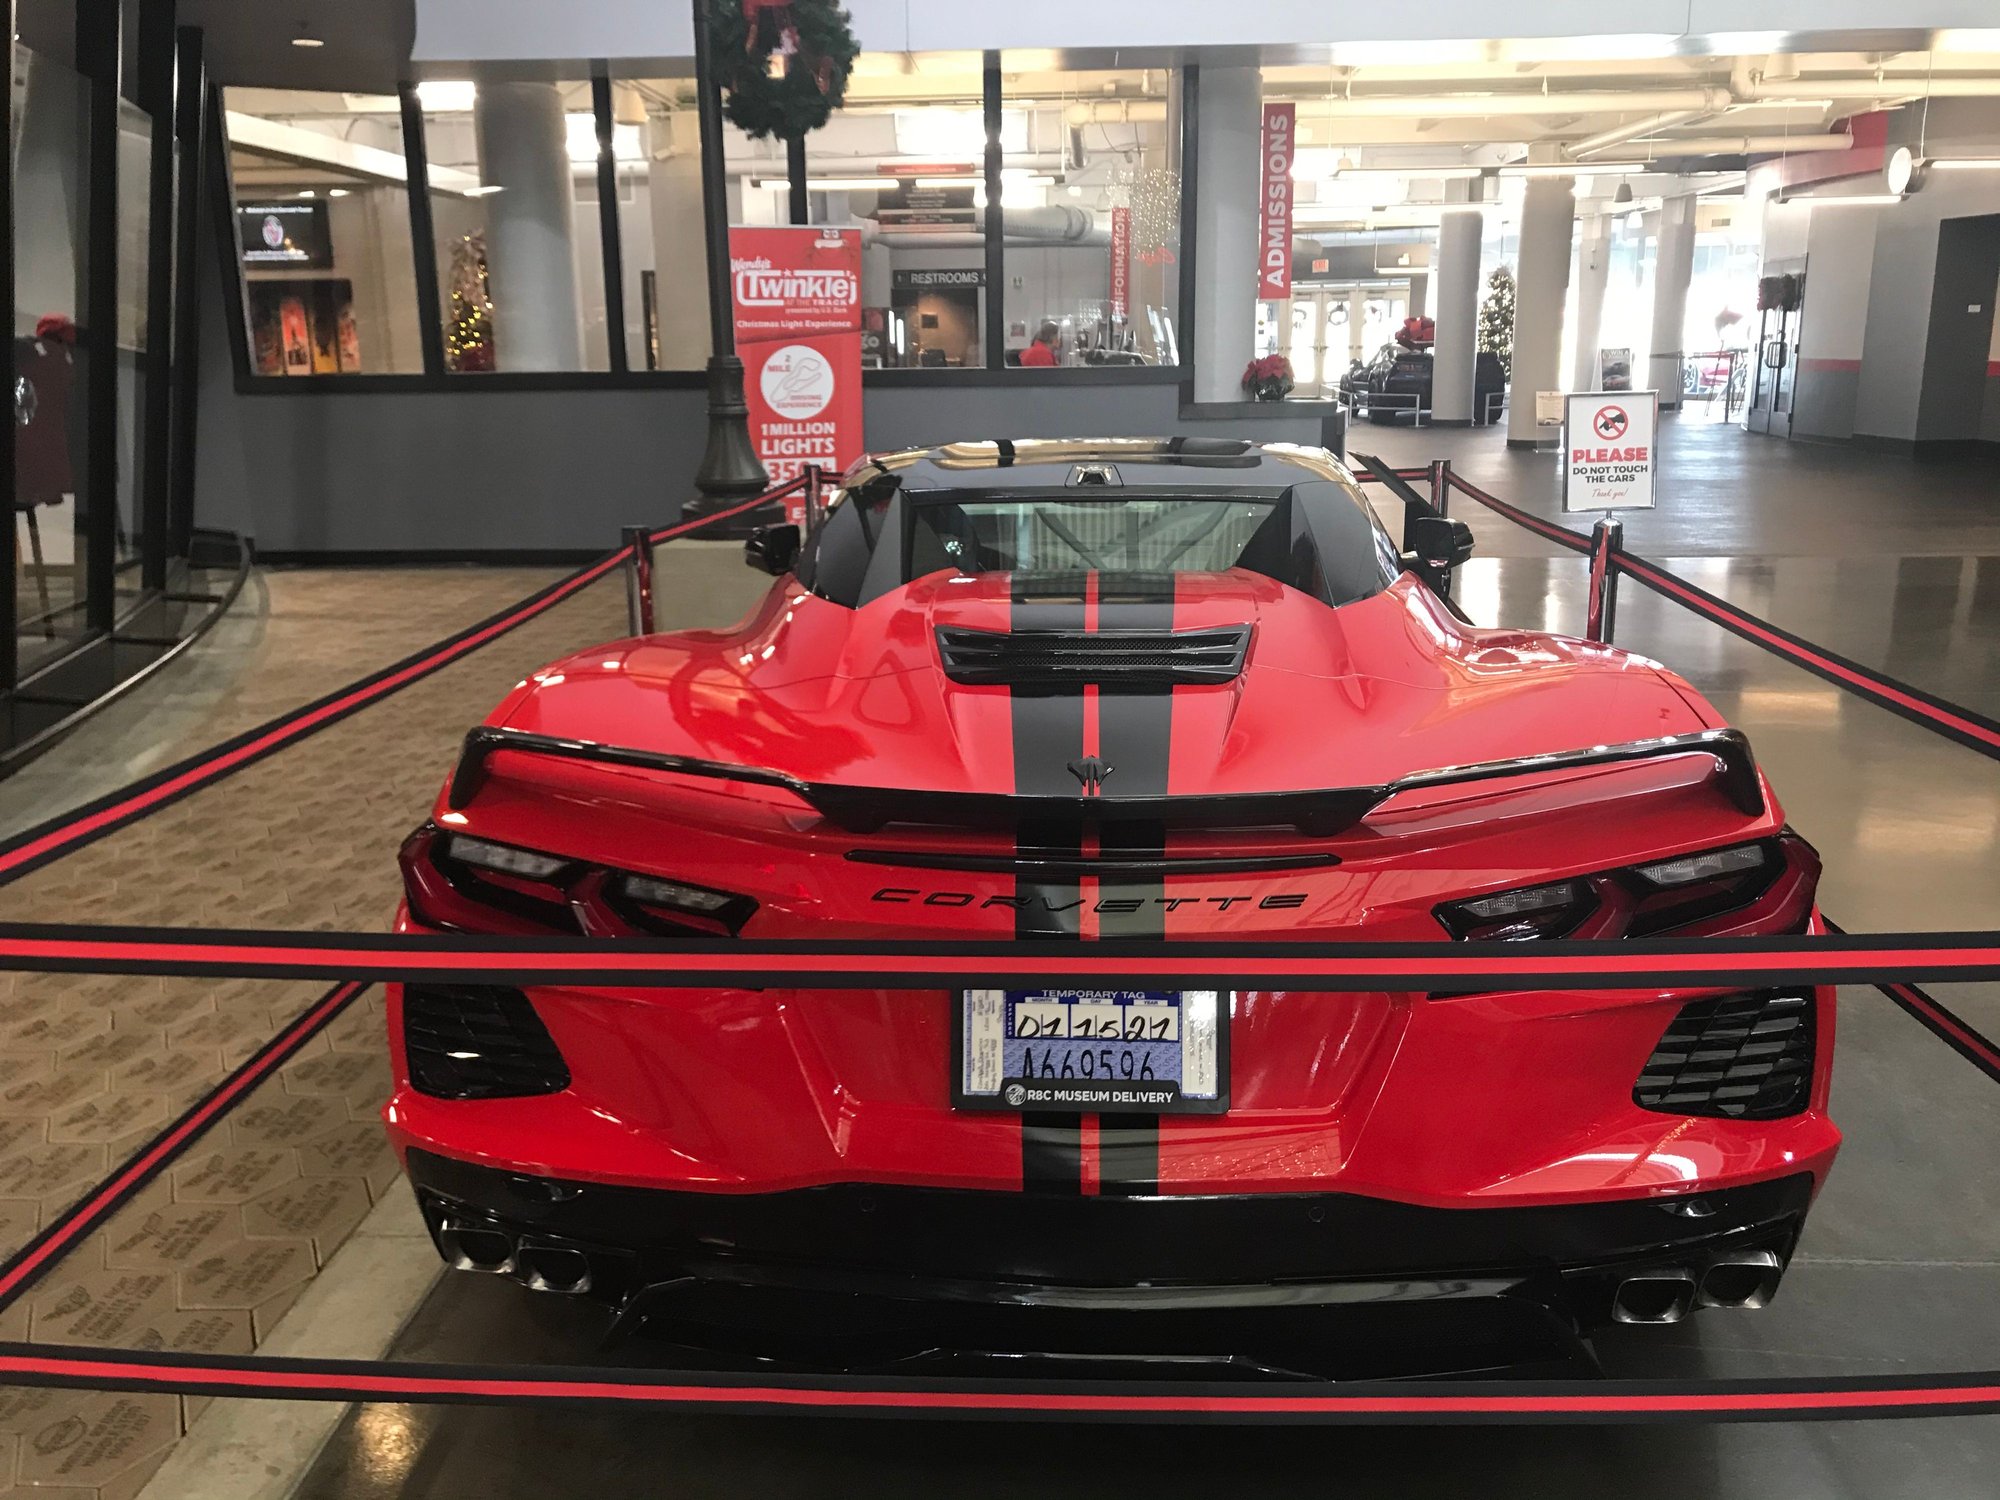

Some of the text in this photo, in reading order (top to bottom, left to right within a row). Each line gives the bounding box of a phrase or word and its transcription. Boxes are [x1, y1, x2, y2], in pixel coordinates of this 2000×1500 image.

[1267, 114, 1288, 288] ADMISSIONS
[730, 256, 772, 272] Wendy's
[1114, 211, 1126, 312] INFORMATION
[745, 271, 849, 298] Twinkle
[910, 272, 979, 284] RESTROOMS
[737, 320, 852, 329] Christmas Light Experience
[770, 422, 836, 435] MILLION
[761, 438, 836, 455] LIGHTS
[1572, 447, 1648, 463] PLEASE
[1573, 465, 1648, 475] DO NOT TOUCH
[1585, 474, 1635, 483] THE CARS
[1592, 488, 1611, 498] Thank
[871, 887, 1308, 913] CORVETTE
[1041, 989, 1146, 999] TEMPORARY TAG
[1027, 1090, 1174, 1103] R8C MUSEUM DELIVERY
